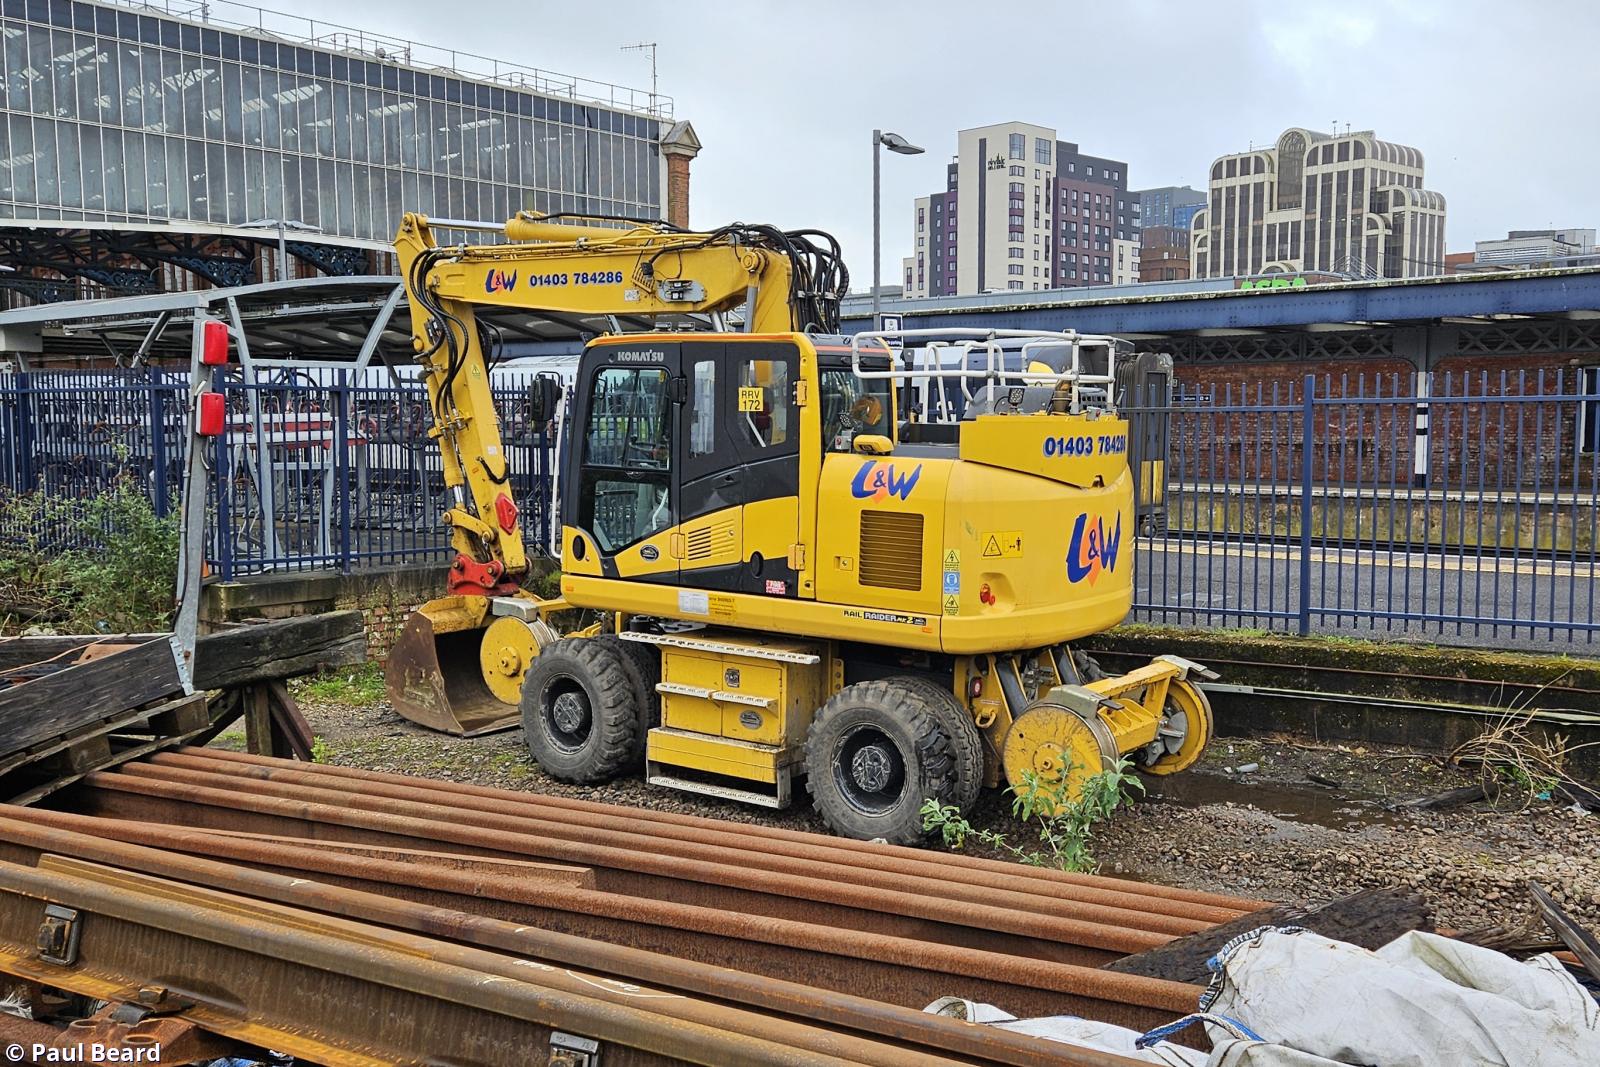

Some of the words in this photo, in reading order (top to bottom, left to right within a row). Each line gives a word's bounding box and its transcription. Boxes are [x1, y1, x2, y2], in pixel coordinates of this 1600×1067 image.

[485, 268, 517, 293] L&W
[530, 274, 568, 287] 01403
[573, 271, 623, 285] 784286
[617, 349, 664, 362] KOMATSU
[741, 390, 760, 399] RRV
[743, 399, 761, 411] 172
[1043, 436, 1094, 456] 01403
[851, 460, 922, 501] L&W
[1066, 509, 1121, 584] L&W
[843, 610, 863, 618] RAIL
[864, 612, 897, 622] RAIDER
